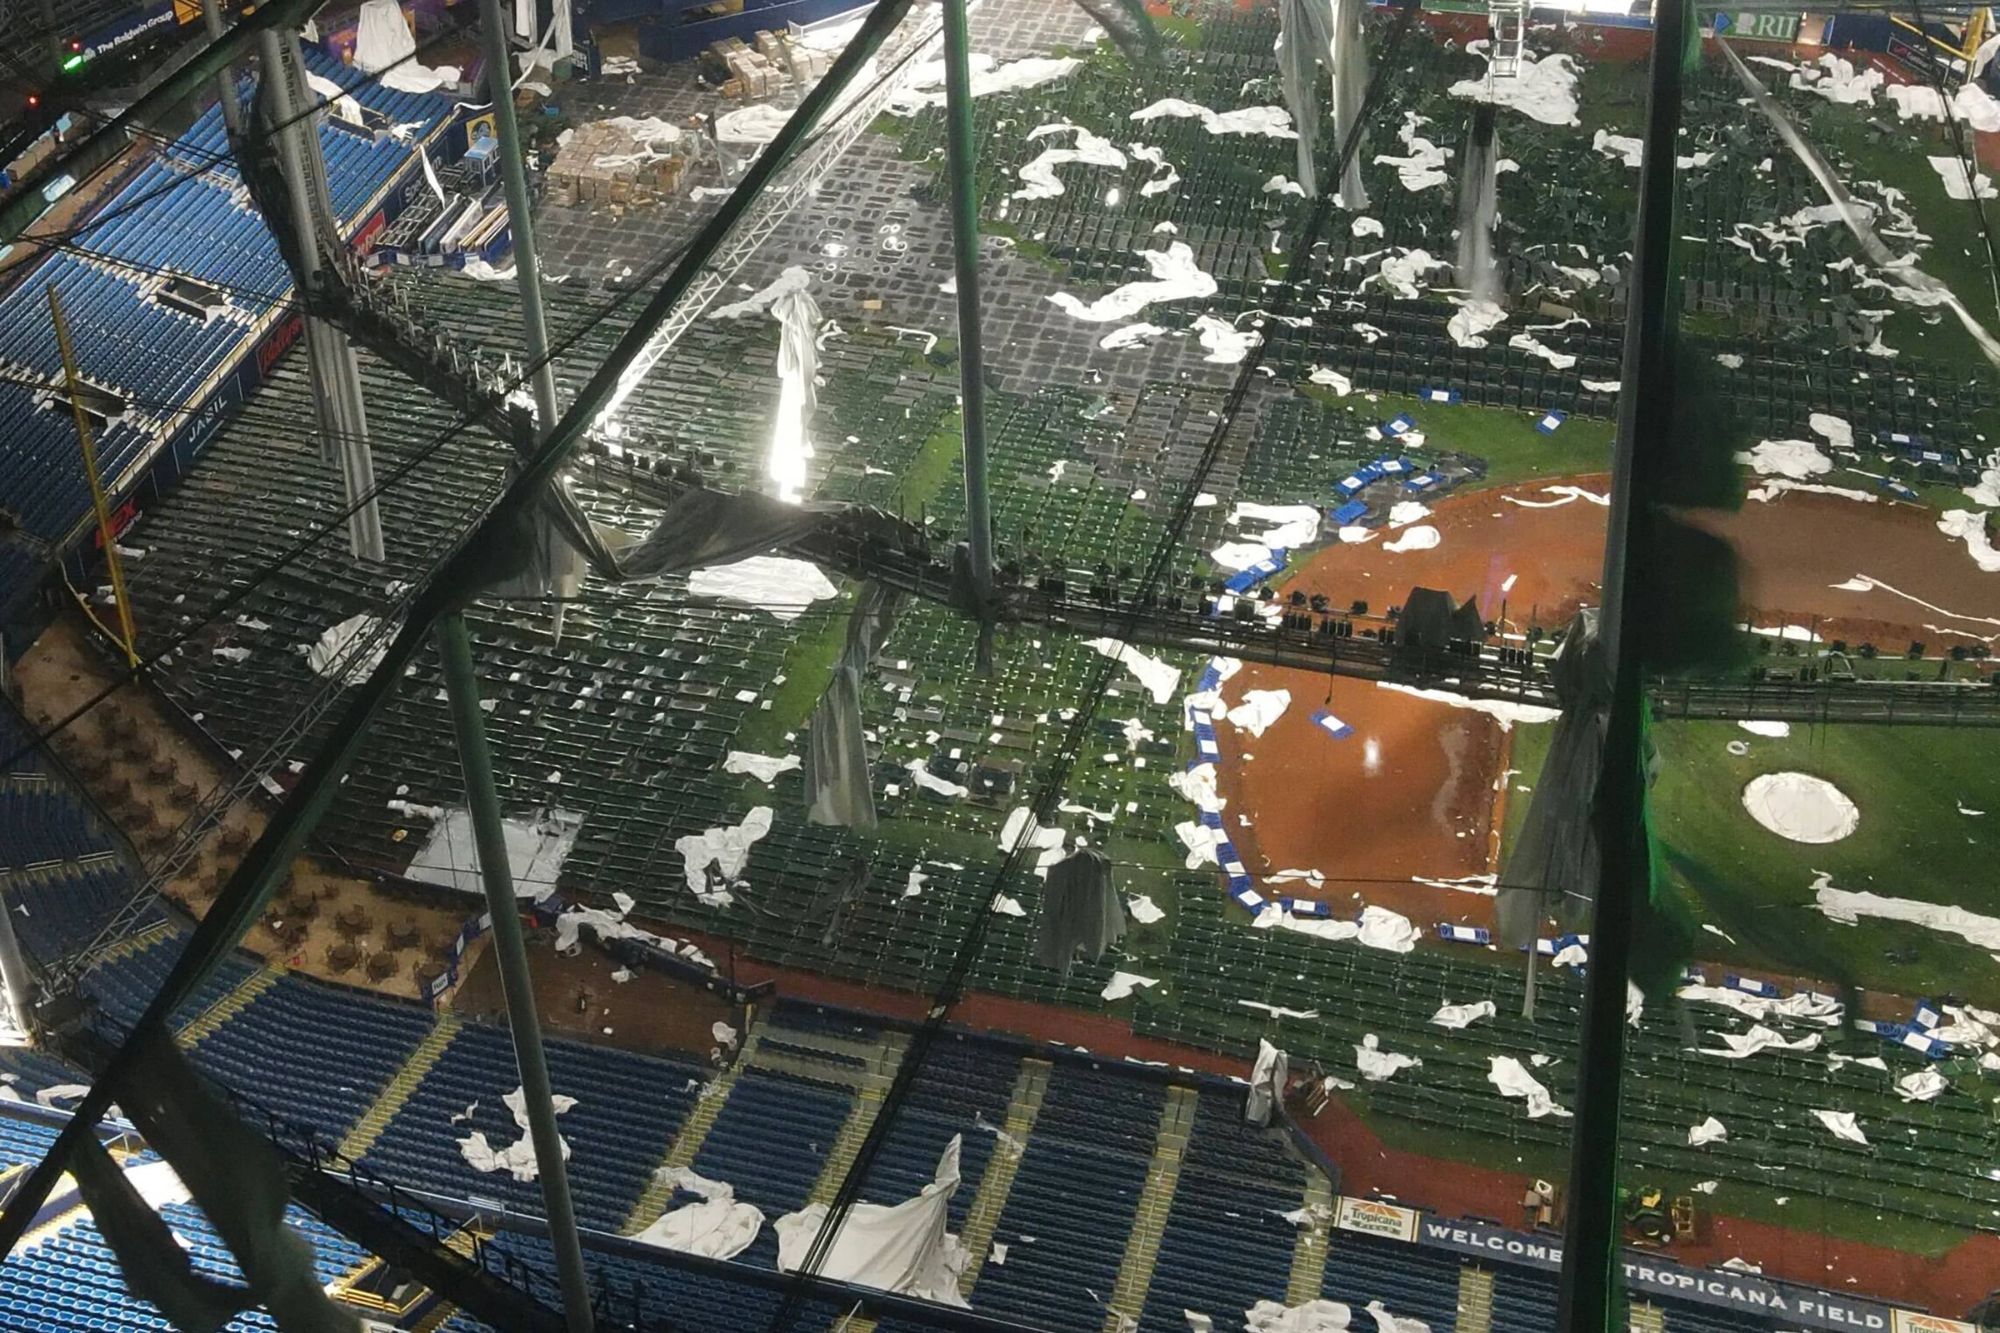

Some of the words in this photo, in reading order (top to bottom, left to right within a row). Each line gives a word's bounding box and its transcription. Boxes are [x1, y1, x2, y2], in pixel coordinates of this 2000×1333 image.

[97, 41, 114, 54] The
[147, 10, 174, 28] Group
[1350, 1206, 1403, 1228] Tropicana
[1427, 1223, 1563, 1264] WELCOME
[1621, 1263, 1788, 1311] TROPICANA
[1799, 1300, 1884, 1329] FIELD
